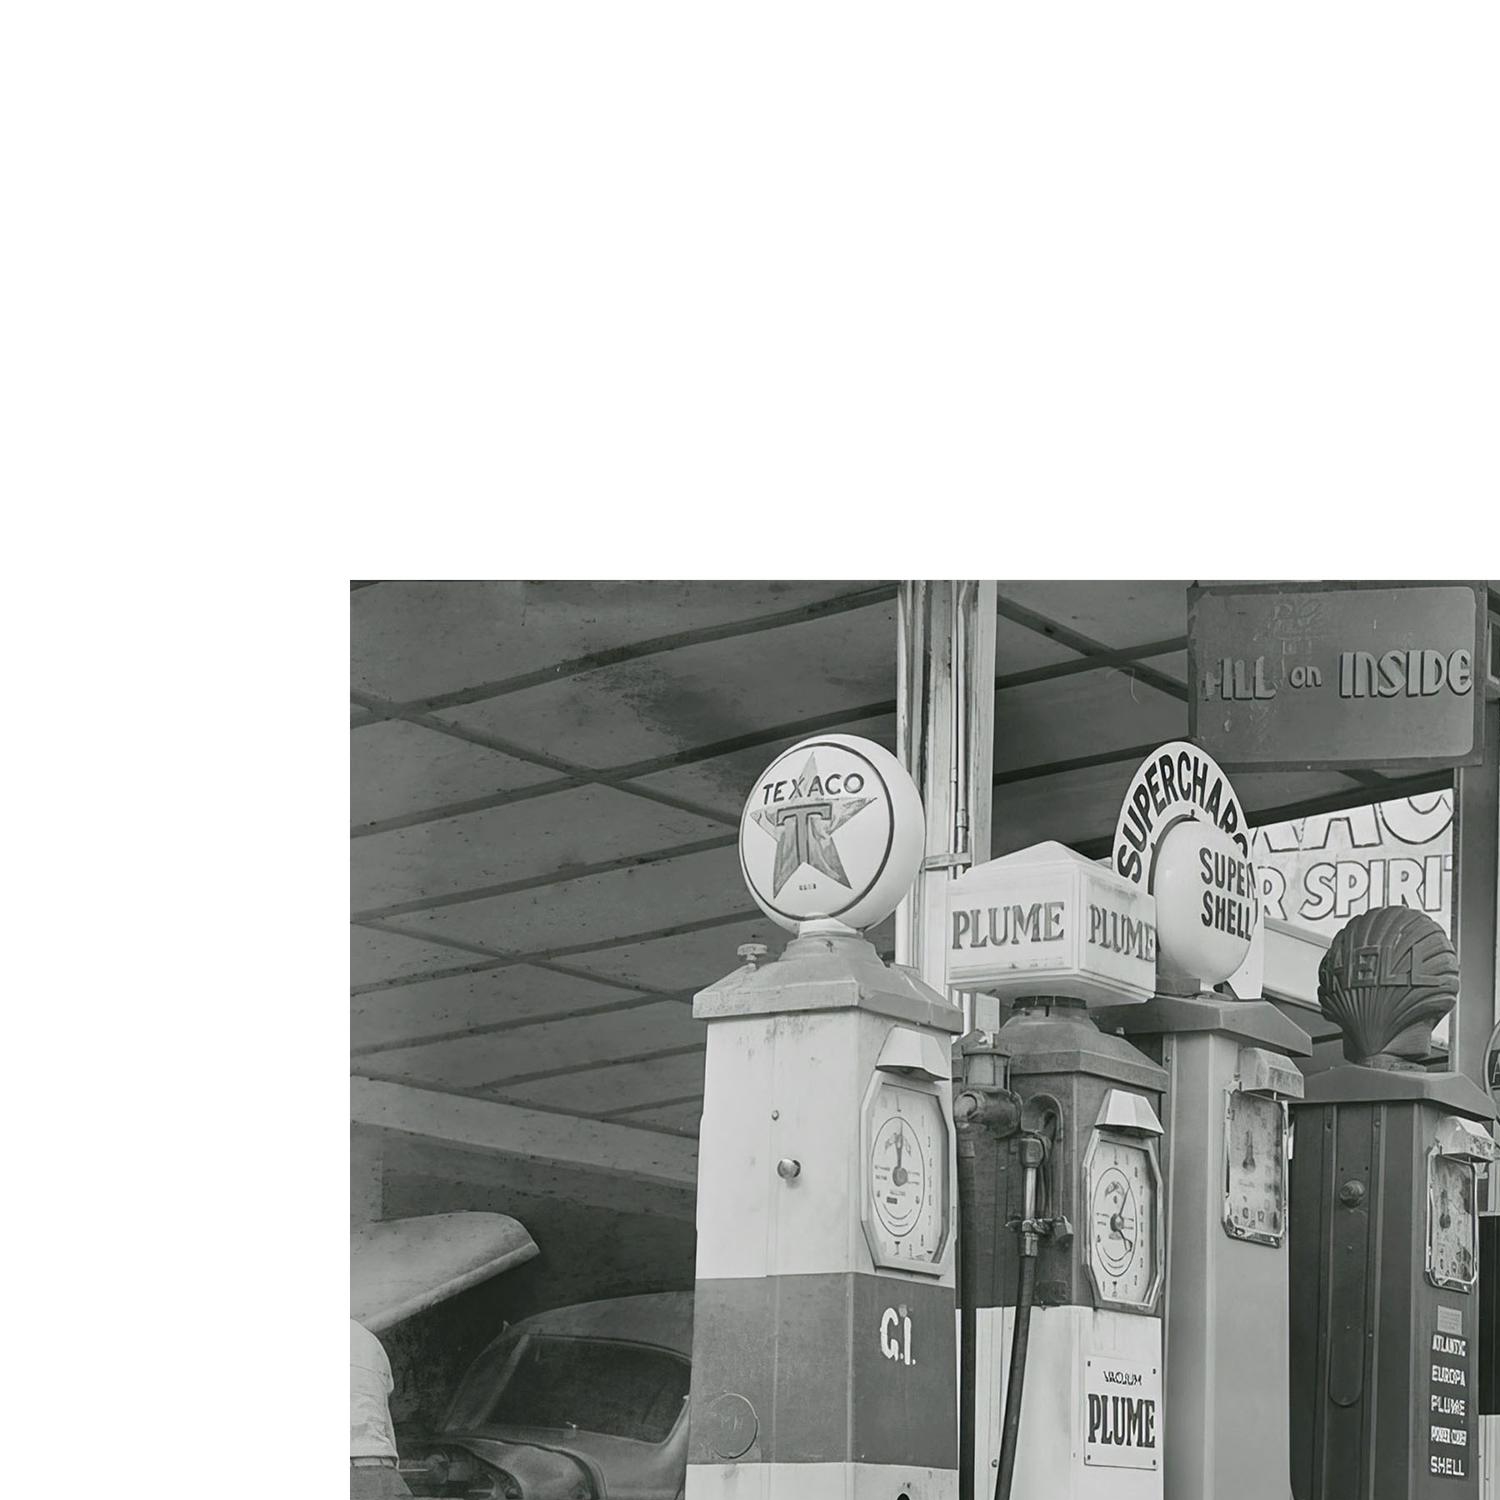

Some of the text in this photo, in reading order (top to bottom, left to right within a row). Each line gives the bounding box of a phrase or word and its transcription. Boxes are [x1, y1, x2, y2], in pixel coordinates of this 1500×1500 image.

[1290, 665, 1322, 688] on
[1339, 649, 1473, 698] INSIDE
[763, 773, 865, 805] TEXACO
[1199, 847, 1256, 900] SUPER
[1298, 855, 1453, 921] SPIRI
[952, 902, 1064, 949] PLUME
[1089, 904, 1156, 962] PLUME
[1201, 890, 1253, 942] SHELL
[1432, 1364, 1465, 1388] EUROPA
[1088, 1394, 1155, 1448] PLUME
[1431, 1394, 1465, 1416] PLUME
[1431, 1455, 1465, 1476] SHELL
